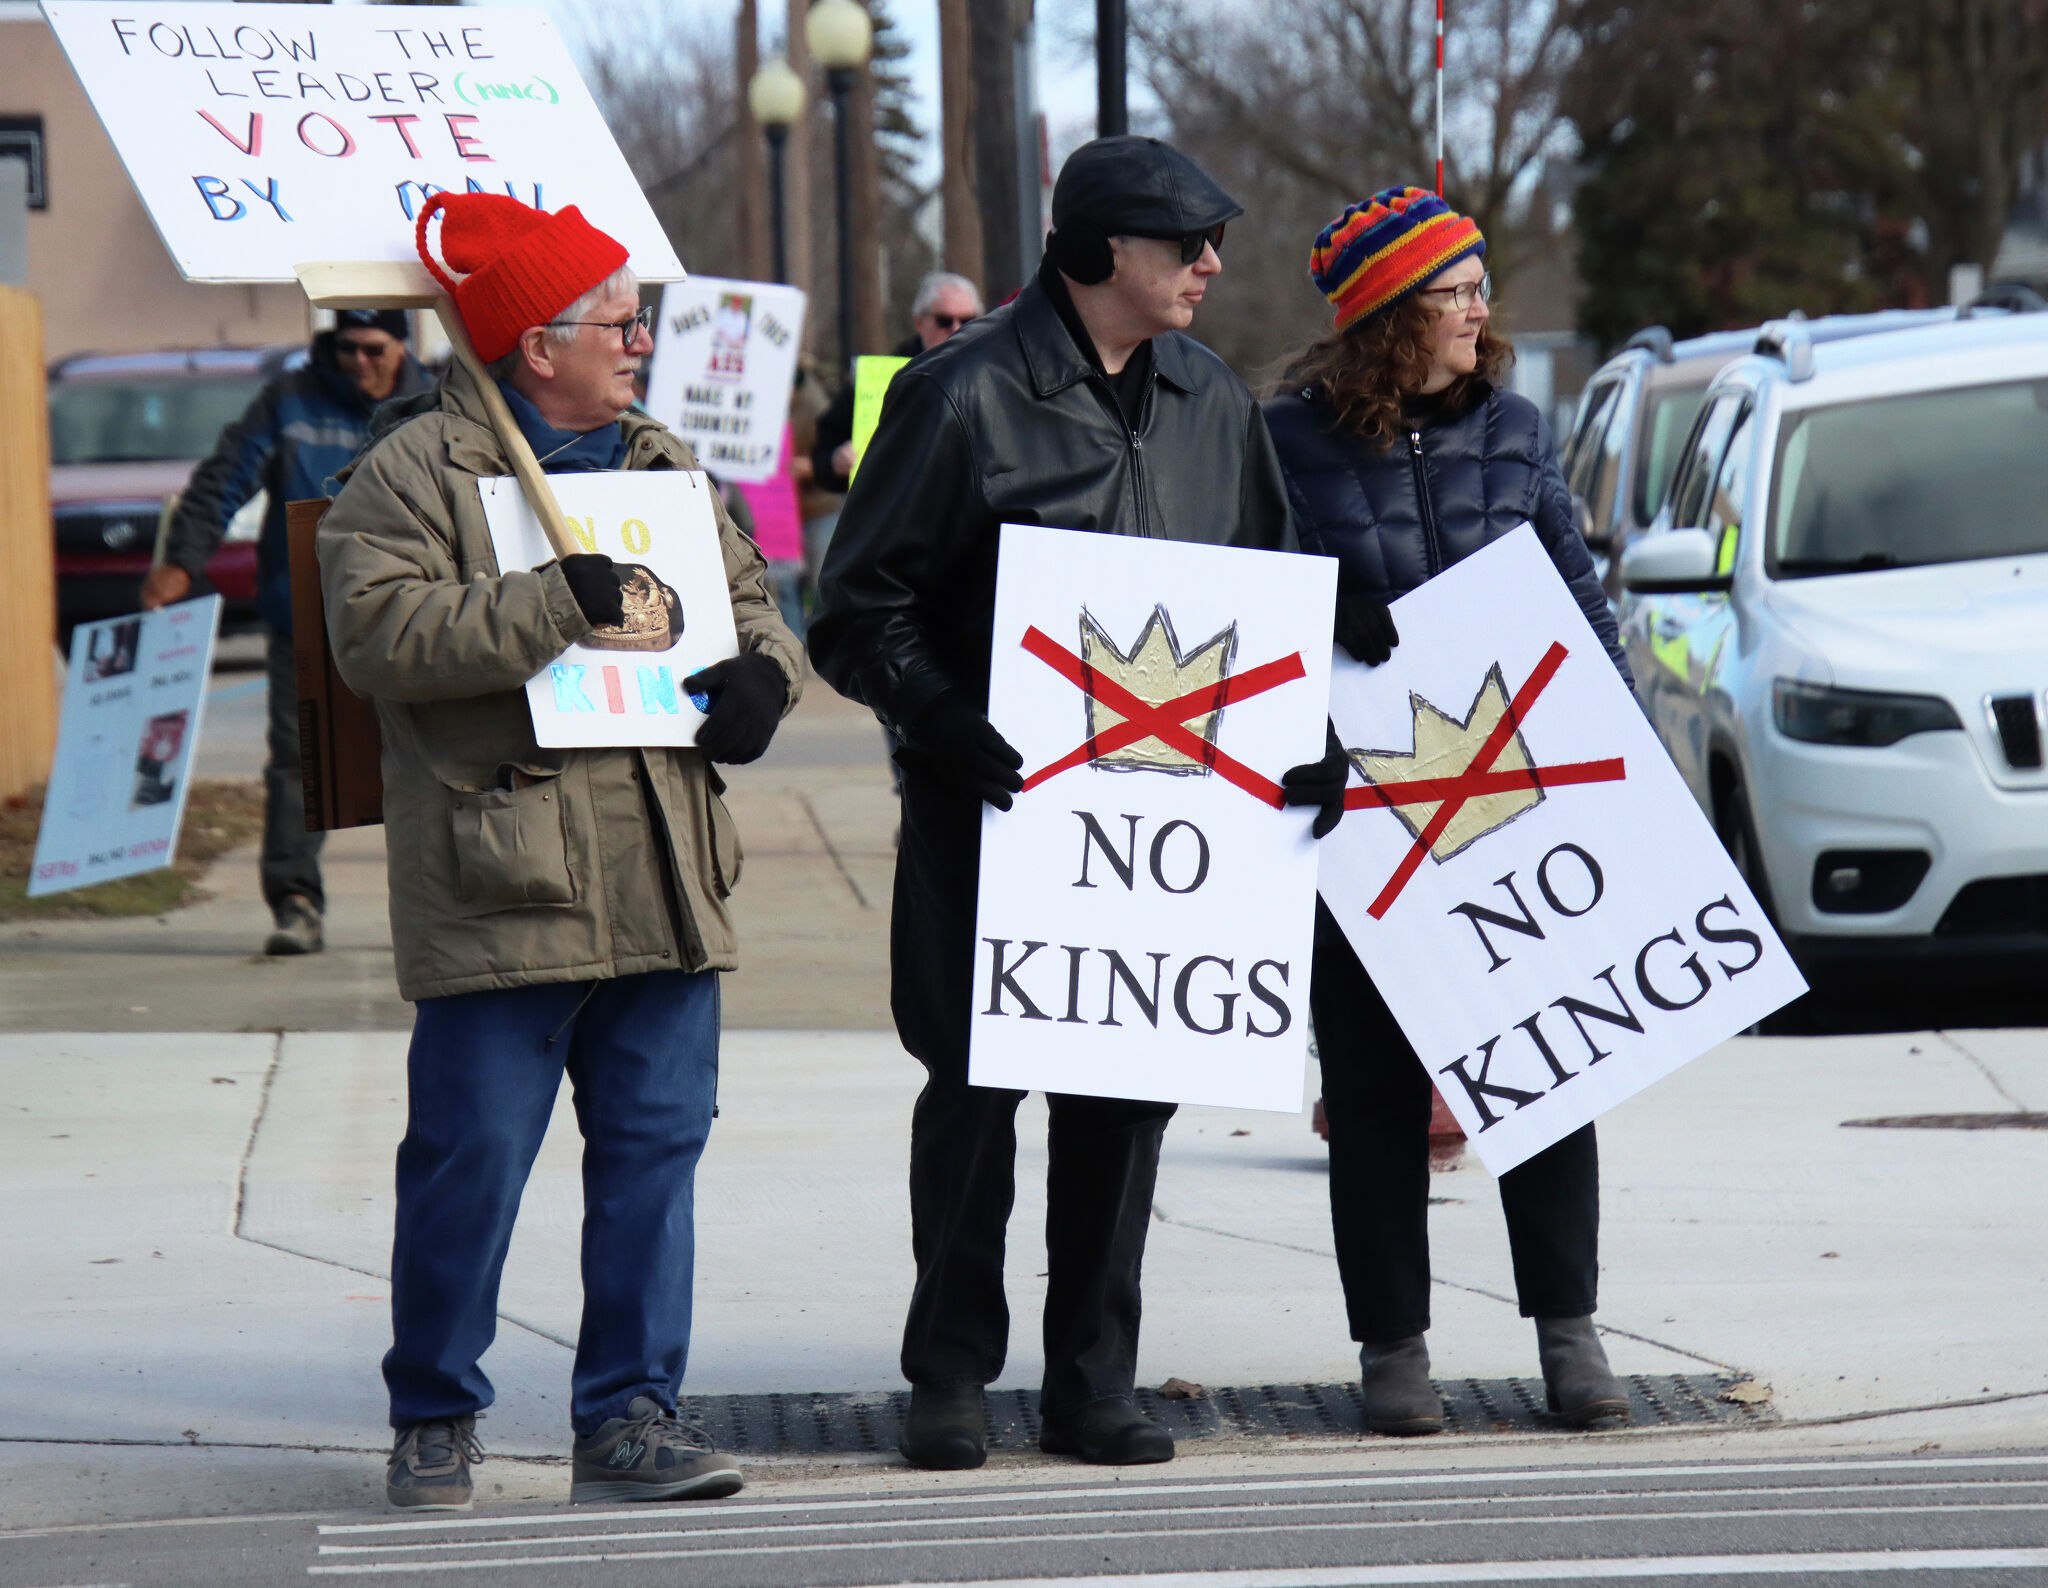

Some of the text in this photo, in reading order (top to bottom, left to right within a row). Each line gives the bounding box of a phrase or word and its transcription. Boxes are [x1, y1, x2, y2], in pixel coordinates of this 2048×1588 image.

[111, 18, 494, 62] FOLLOW THE
[205, 69, 445, 104] LEADER
[195, 109, 497, 162] VOTE
[191, 175, 294, 222] BY
[564, 516, 652, 555] NO
[1071, 810, 1210, 894] NO
[1447, 842, 1604, 973] NO
[981, 937, 1292, 1038] KINGS
[1438, 893, 1763, 1133] KINGS
